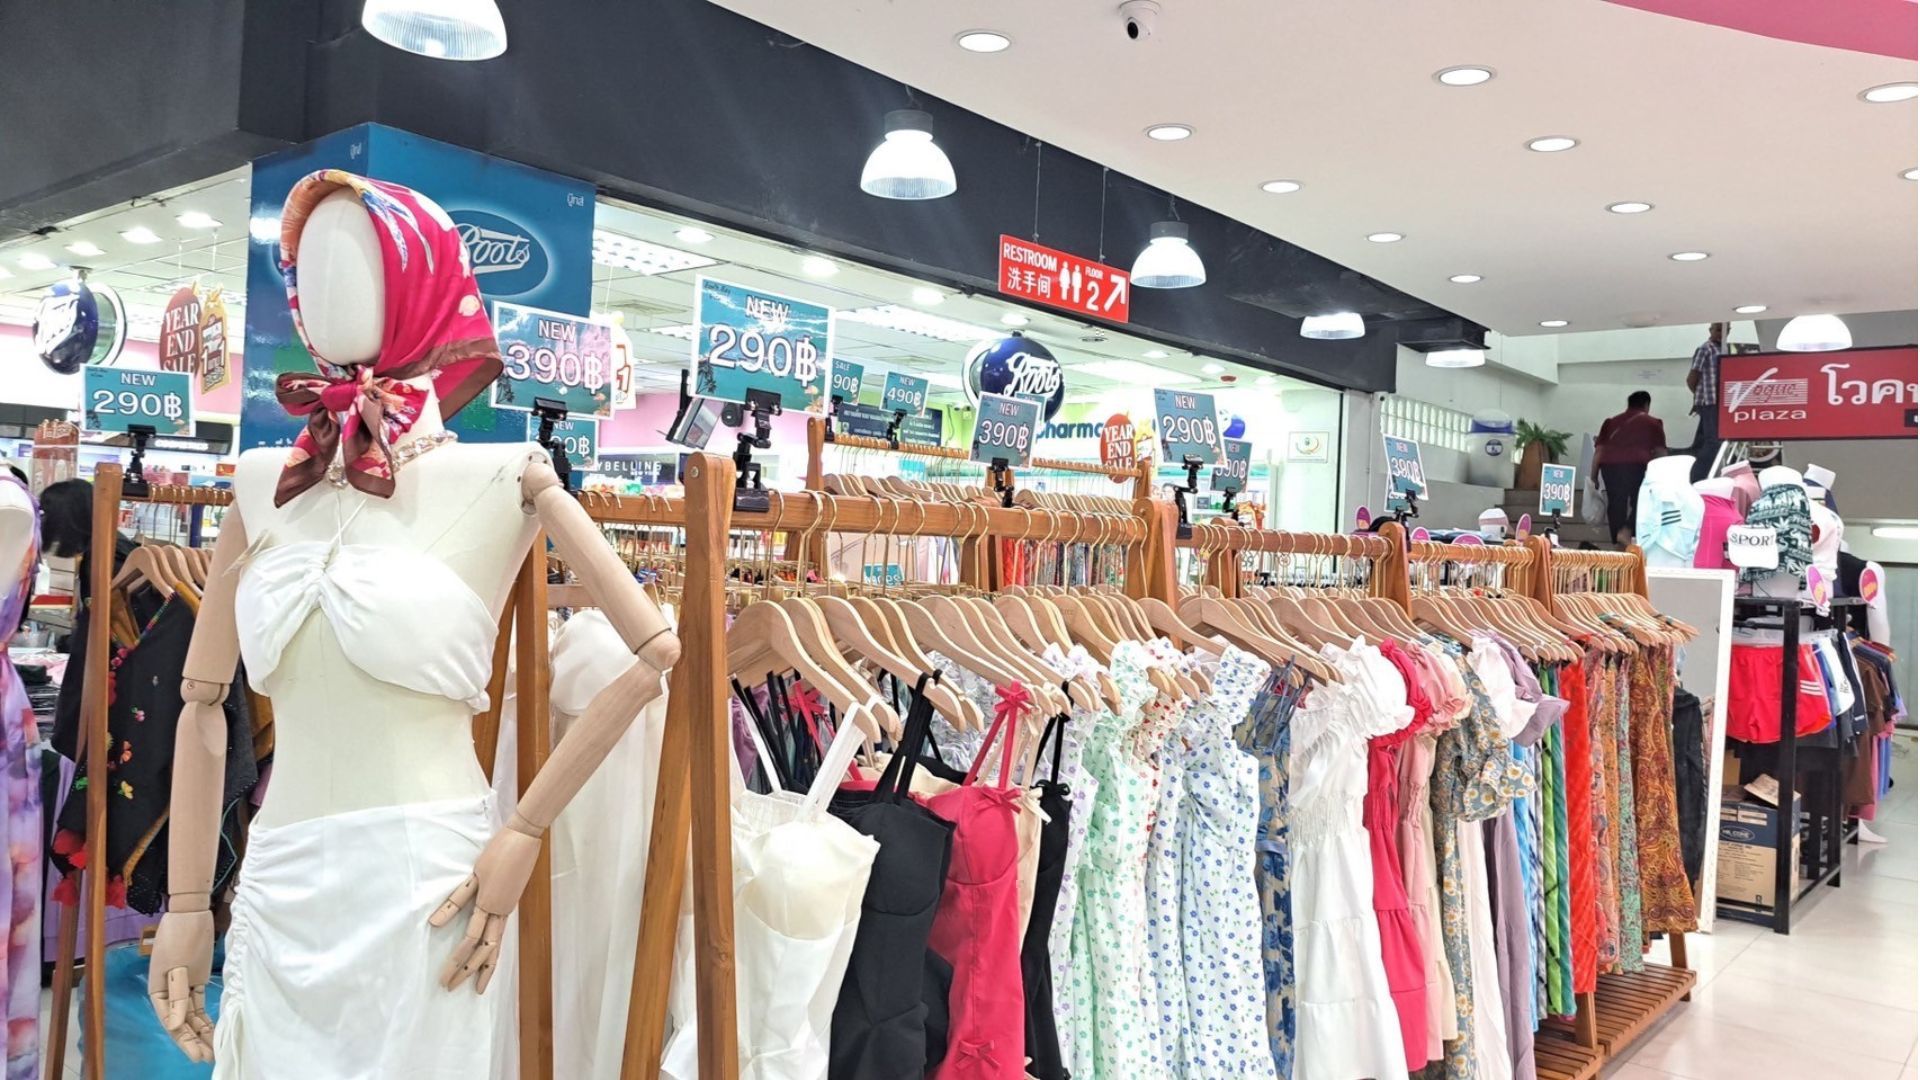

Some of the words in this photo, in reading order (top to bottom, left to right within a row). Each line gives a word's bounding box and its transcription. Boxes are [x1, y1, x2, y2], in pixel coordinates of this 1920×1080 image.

[1003, 242, 1058, 272] RESTROOM
[1007, 266, 1052, 298] 洗手间
[1085, 266, 1104, 279] FLOOR
[1086, 281, 1100, 311] 2
[164, 302, 199, 334] YEAR
[746, 295, 790, 324] NEW
[538, 320, 576, 342] NEW
[167, 329, 196, 362] END
[708, 323, 818, 388] 290฿
[163, 353, 196, 373] SALE
[506, 343, 605, 395] 390฿
[835, 361, 851, 371] SALE
[121, 373, 156, 386] NEW
[833, 374, 859, 394] 90฿
[900, 377, 915, 386] NEW
[1003, 352, 1062, 398] Boots
[887, 387, 922, 408] 490฿
[1174, 393, 1196, 409] NEW
[1728, 367, 1797, 413] Vogue
[93, 390, 182, 421] 290฿
[1000, 402, 1019, 417] NEW
[1734, 408, 1807, 424] plaza
[554, 421, 575, 430] NEW
[979, 419, 1029, 451] 390฿
[1103, 424, 1133, 443] YEAR
[1162, 415, 1216, 448] 290฿
[1107, 441, 1132, 459] END
